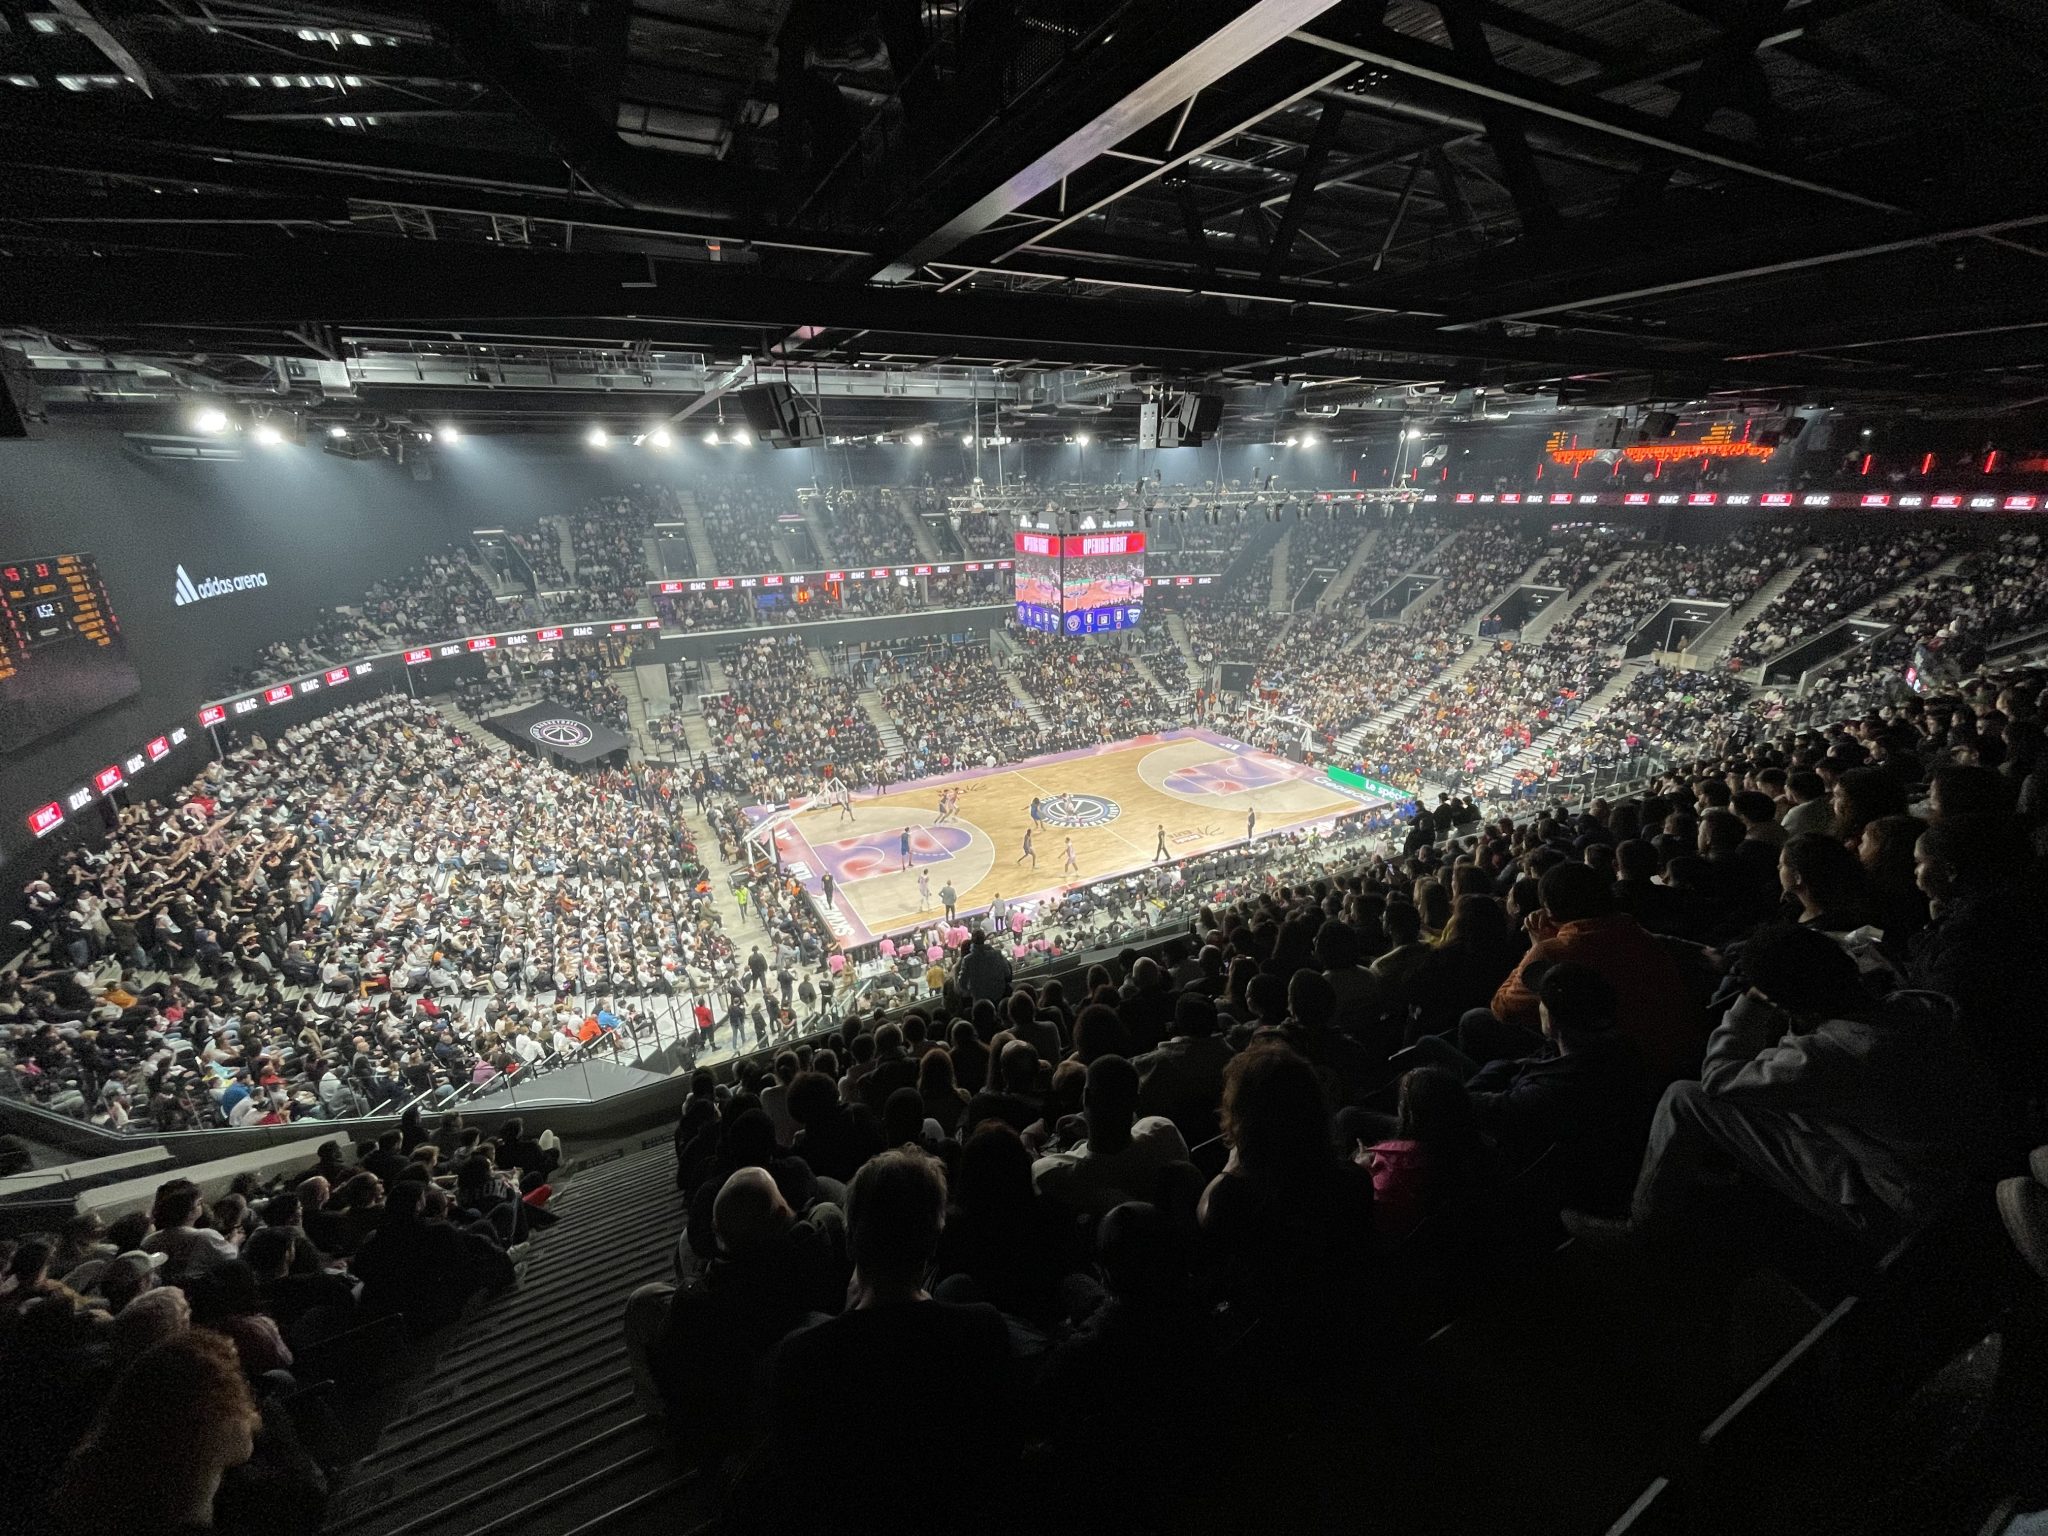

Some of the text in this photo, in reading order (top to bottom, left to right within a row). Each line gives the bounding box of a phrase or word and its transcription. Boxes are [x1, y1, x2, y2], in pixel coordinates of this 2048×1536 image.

[1658, 496, 1679, 504] RMC
[1727, 496, 1749, 504] RMC
[1804, 496, 1829, 505] RMC
[1971, 499, 1994, 507] RMC
[1084, 538, 1109, 554] OPENING
[198, 573, 268, 598] adidas arena
[742, 579, 756, 587] RMC
[574, 627, 592, 636] RMC
[508, 635, 527, 645] RMC
[411, 651, 426, 659] RMC
[441, 645, 460, 656] RMC
[356, 663, 372, 674] RMC
[331, 671, 344, 680] RMC
[301, 679, 319, 692] RMC
[272, 688, 287, 699] RMC
[235, 698, 257, 713] RMC
[127, 754, 145, 774] RMC
[102, 770, 117, 787] RMC
[1366, 779, 1376, 791] Le
[69, 788, 92, 810] RMC
[37, 808, 57, 827] RMC
